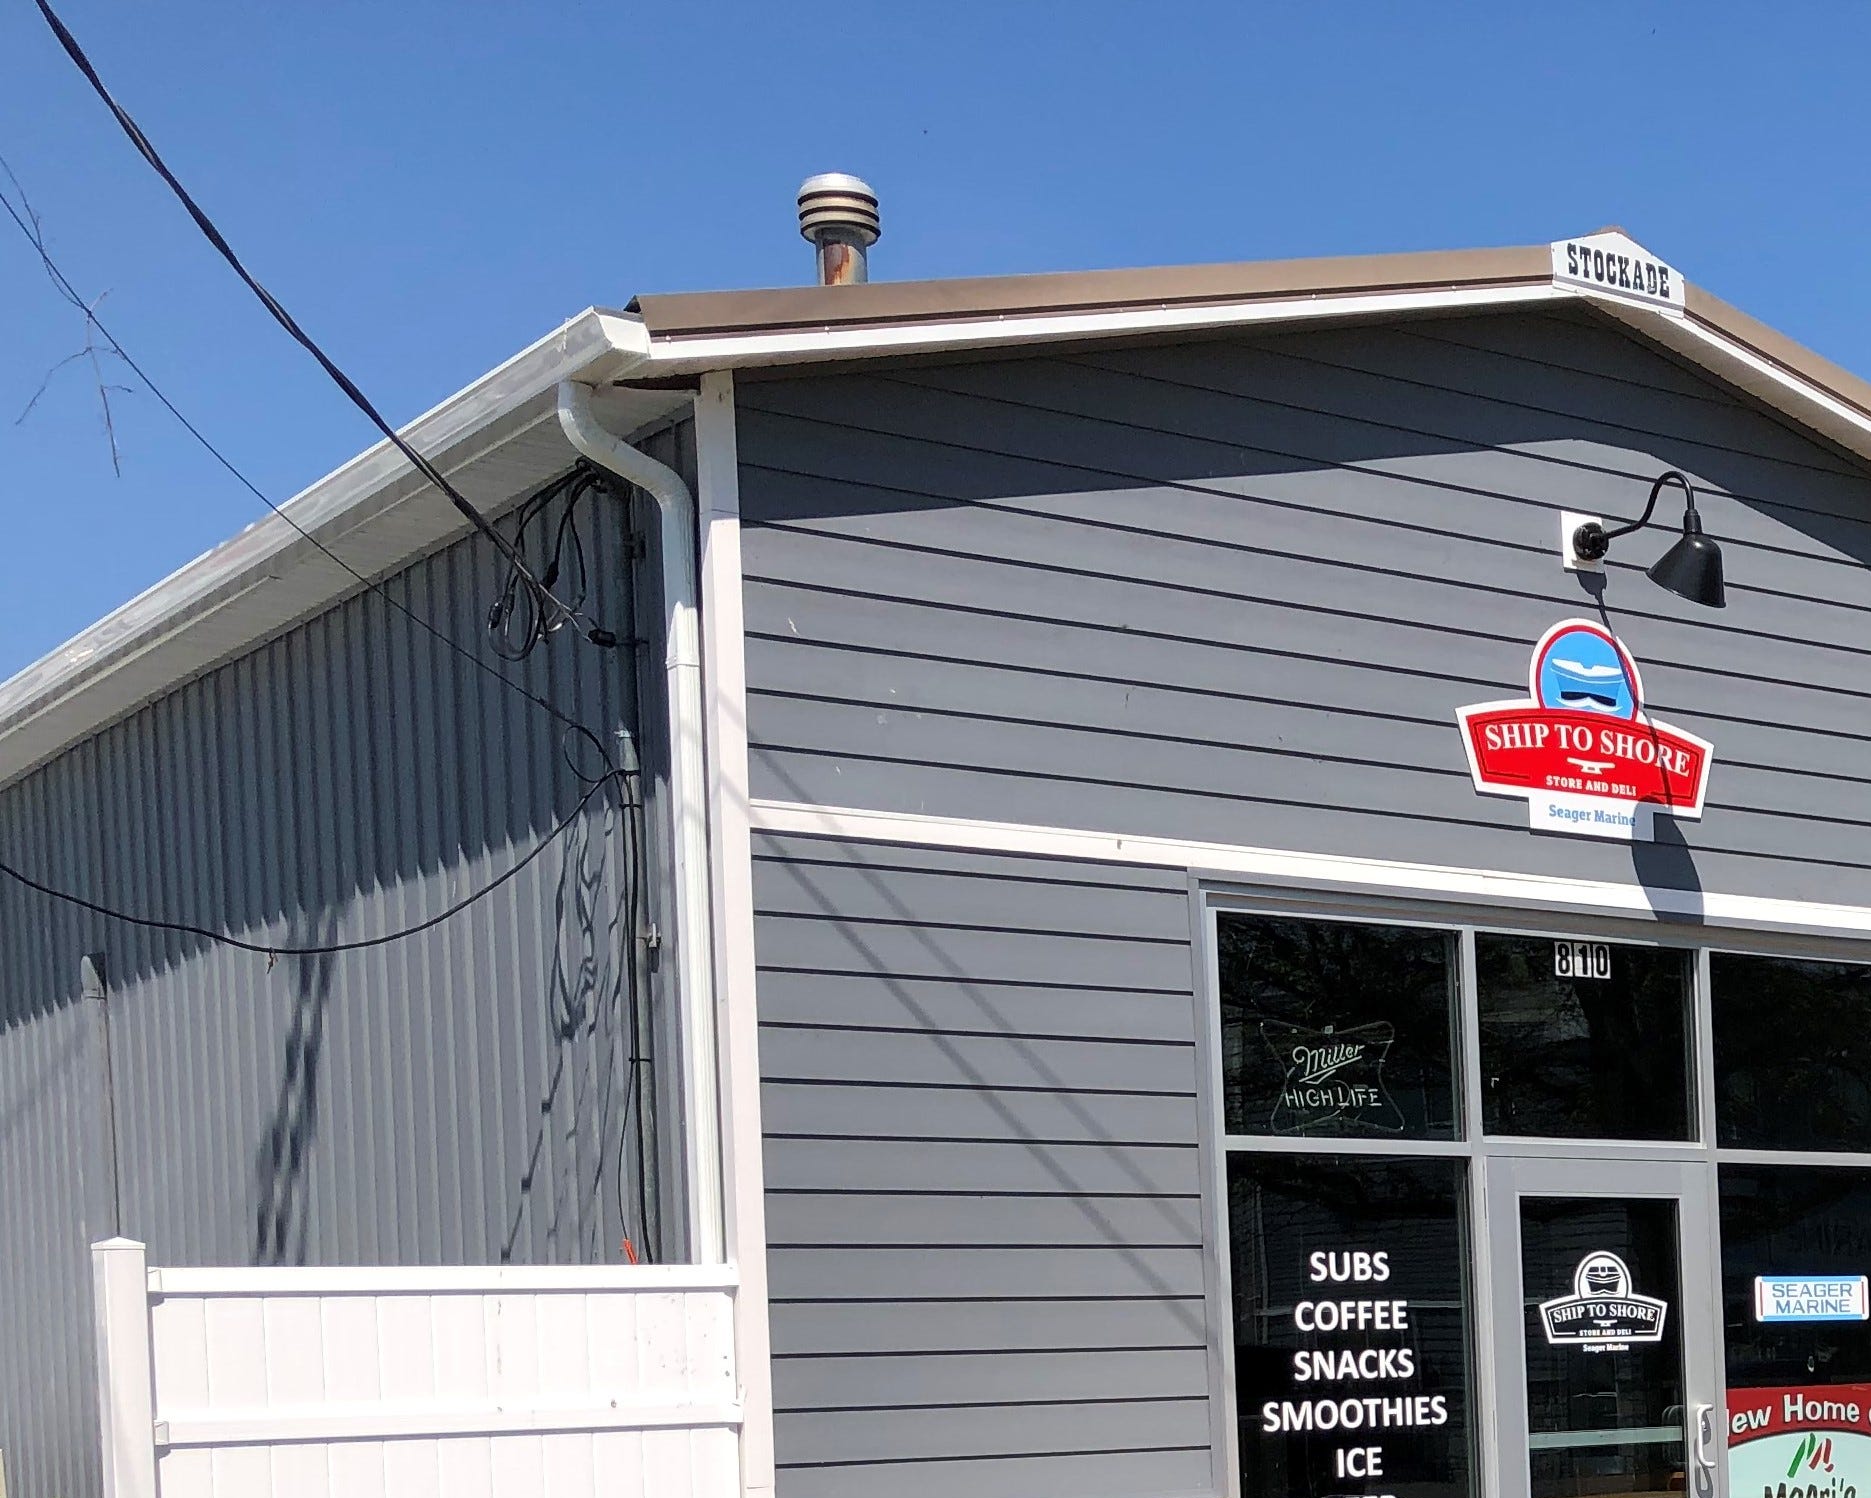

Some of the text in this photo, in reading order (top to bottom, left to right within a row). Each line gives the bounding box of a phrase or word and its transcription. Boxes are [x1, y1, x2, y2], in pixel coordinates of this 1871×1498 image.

[1566, 242, 1671, 300] STOCKADE
[1484, 722, 1691, 777] SHIP TO SHORE
[1545, 775, 1637, 797] STORE AND DELI
[1548, 804, 1636, 827] Seager Marine
[1557, 943, 1609, 977] 810
[1292, 1043, 1366, 1077] Miller
[1285, 1086, 1383, 1108] HIGH LIFE
[1310, 1251, 1390, 1282] SUBS
[1772, 1283, 1853, 1298] SEAGER
[1294, 1300, 1409, 1331] COFFEE
[1553, 1303, 1655, 1323] SHIP TO SHORE
[1775, 1299, 1851, 1314] MARINE
[1616, 1328, 1632, 1336] DELI
[1582, 1344, 1606, 1353] Seager
[1294, 1348, 1415, 1382] SNACKS
[1262, 1395, 1448, 1432] SMOOTHIES
[1784, 1393, 1860, 1424] Home
[1336, 1446, 1384, 1478] ICE
